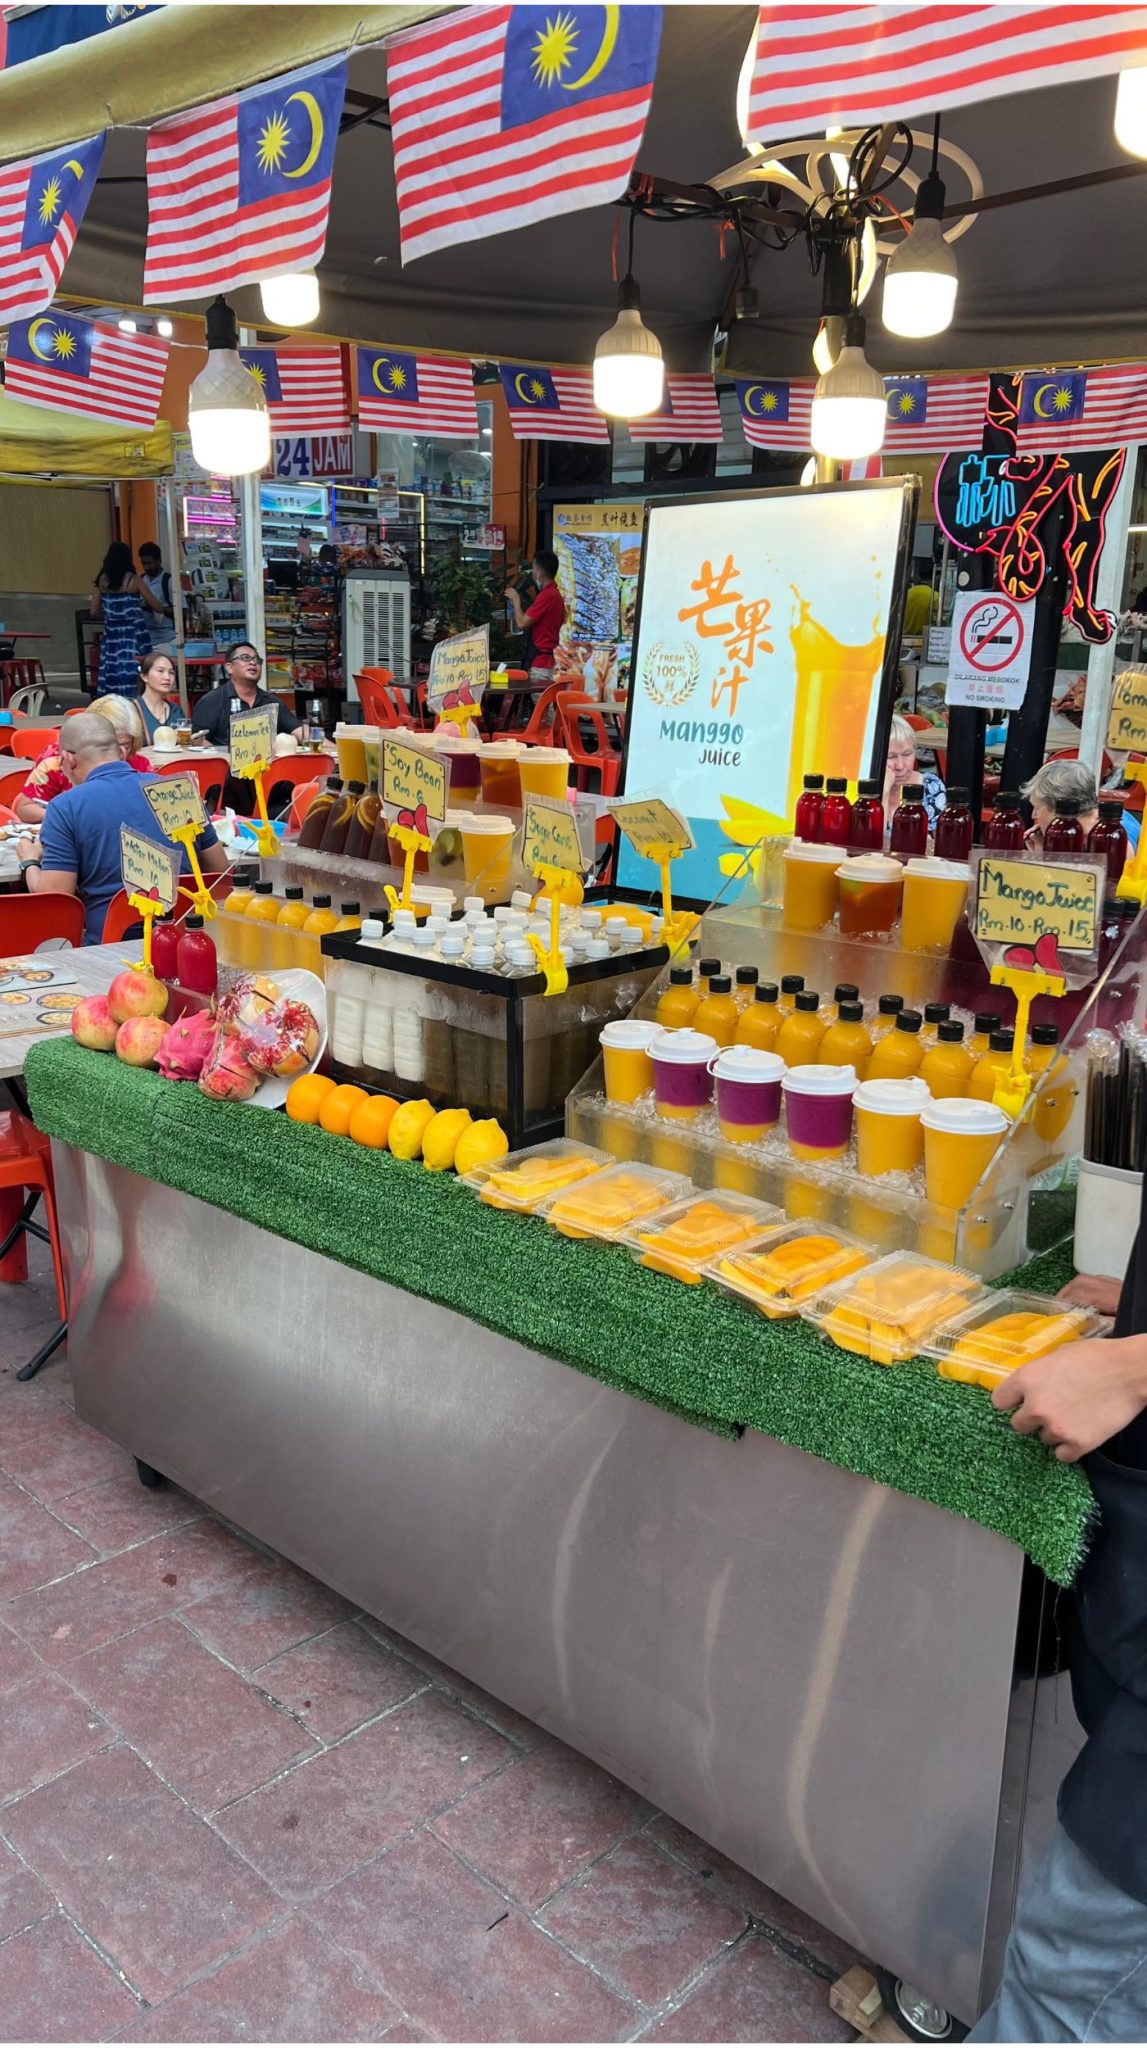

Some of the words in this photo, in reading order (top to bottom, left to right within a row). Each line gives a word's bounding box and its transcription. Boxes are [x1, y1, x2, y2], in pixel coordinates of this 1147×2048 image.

[276, 438, 309, 477] 24
[314, 435, 351, 472] JAM
[659, 653, 686, 663] FRESH
[656, 665, 688, 678] 100%
[954, 673, 987, 682] DILARANG
[987, 675, 1021, 685] MEROKOK
[965, 693, 975, 702] NO
[976, 694, 1006, 703] SMOKING
[660, 719, 744, 746] Manggo
[389, 746, 411, 779] Soy
[415, 758, 442, 791] Bean
